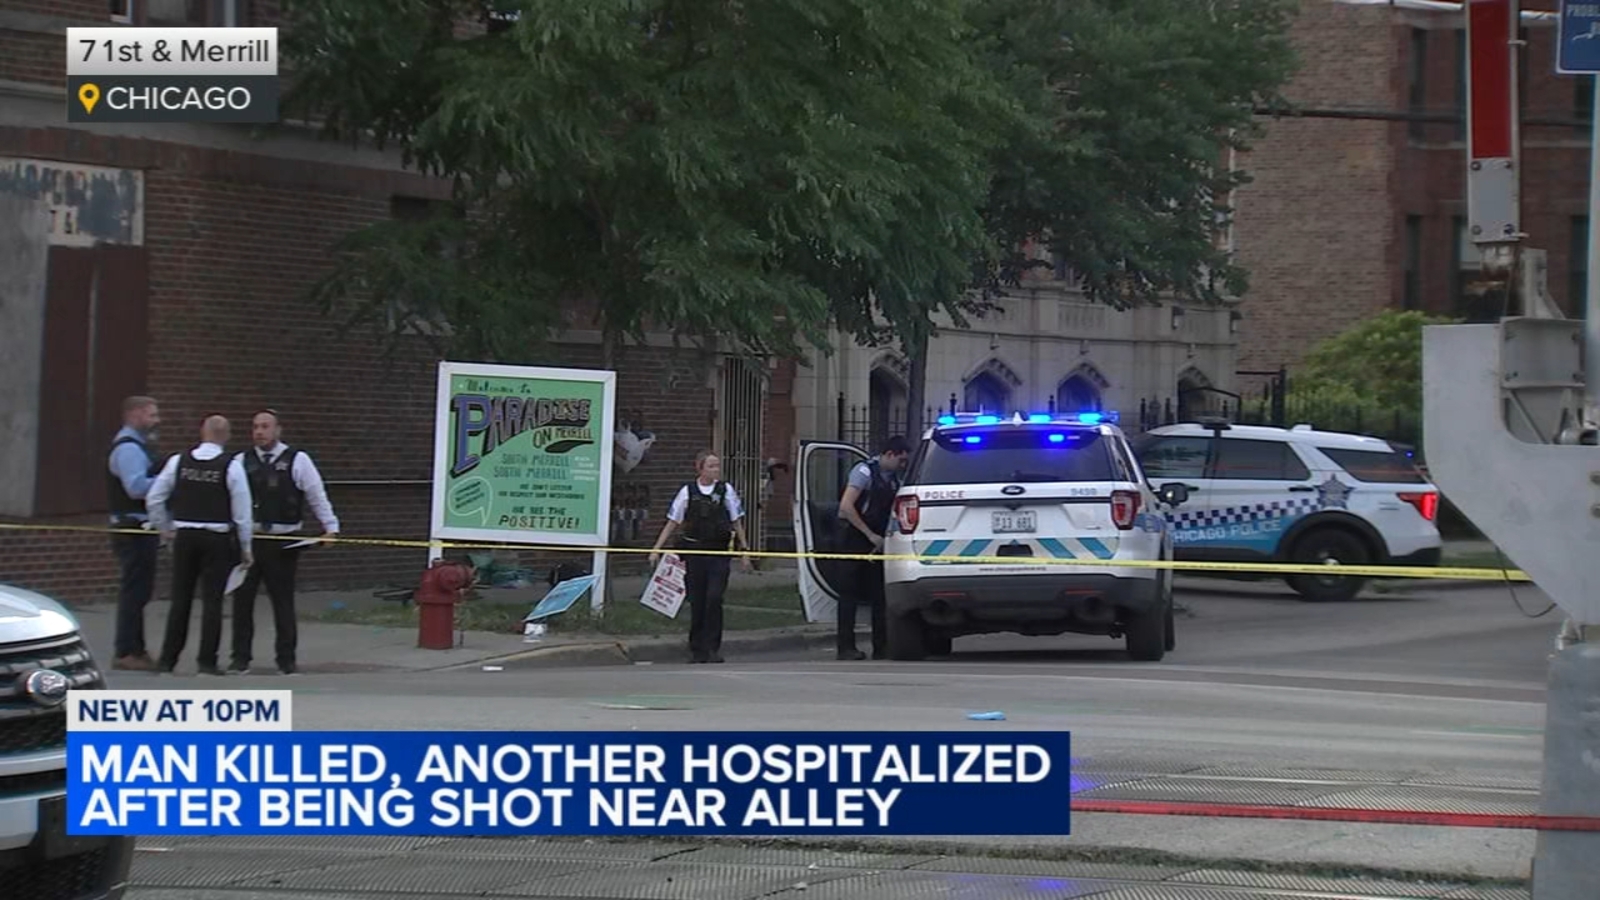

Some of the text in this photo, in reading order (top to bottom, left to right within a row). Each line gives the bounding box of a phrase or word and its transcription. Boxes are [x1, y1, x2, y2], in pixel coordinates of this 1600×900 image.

[450, 393, 591, 478] PARADISE
[533, 427, 552, 449] ON
[180, 467, 221, 483] POLICE
[924, 489, 964, 500] POLICE
[547, 506, 567, 516] THE
[498, 514, 580, 530] POSITIVE!
[1171, 519, 1282, 543] HICAGO POLICE
